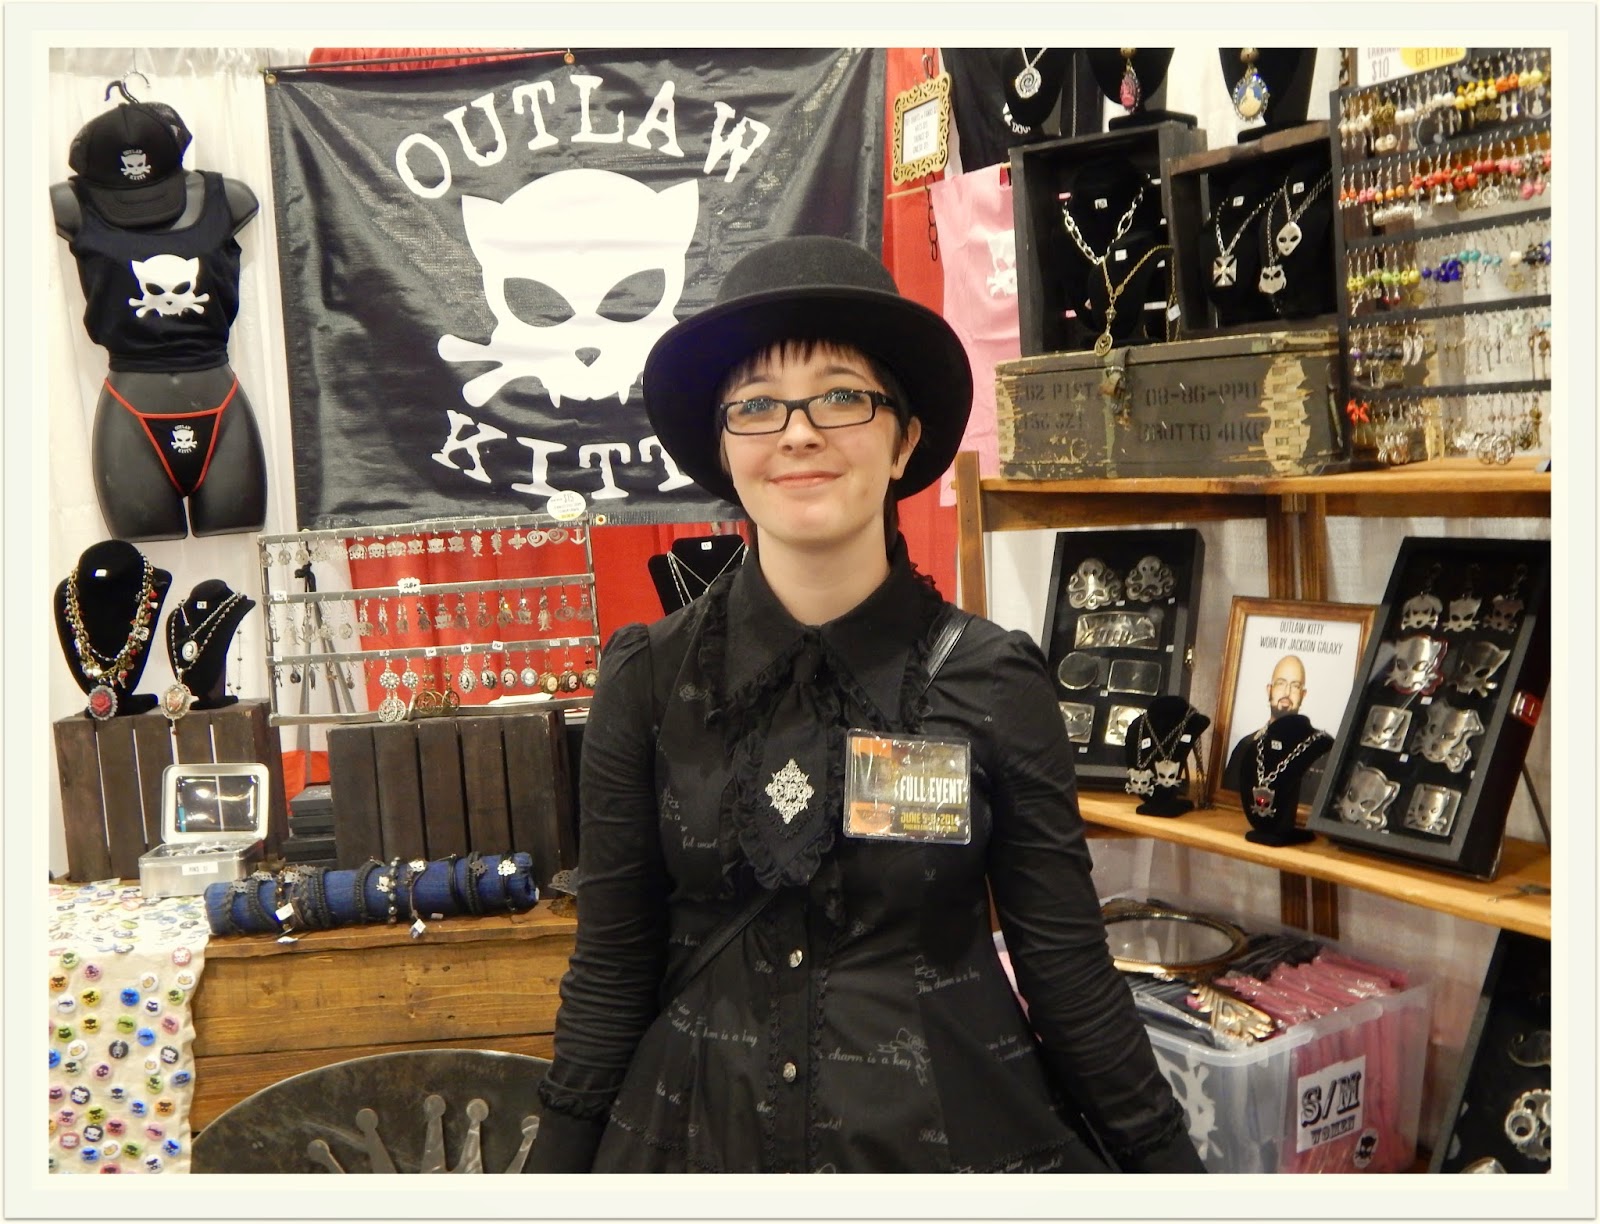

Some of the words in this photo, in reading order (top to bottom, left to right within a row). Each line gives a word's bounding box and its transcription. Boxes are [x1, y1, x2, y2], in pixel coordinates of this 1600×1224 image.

[1372, 56, 1389, 82] $10
[1415, 48, 1430, 66] GET
[395, 74, 771, 200] OUTLAW
[431, 409, 694, 500] KITT
[1280, 621, 1305, 635] OUTLAW
[1307, 623, 1325, 636] KITTY
[1260, 636, 1278, 649] WORN
[1279, 637, 1288, 650] BY
[1288, 638, 1315, 653] JACKSON
[1317, 641, 1343, 655] GALAXY
[900, 776, 927, 803] FULL
[929, 777, 964, 805] EVENT
[900, 811, 921, 825] JUNE
[1301, 1071, 1362, 1128] S/M
[1310, 1114, 1356, 1145] WOMEN
